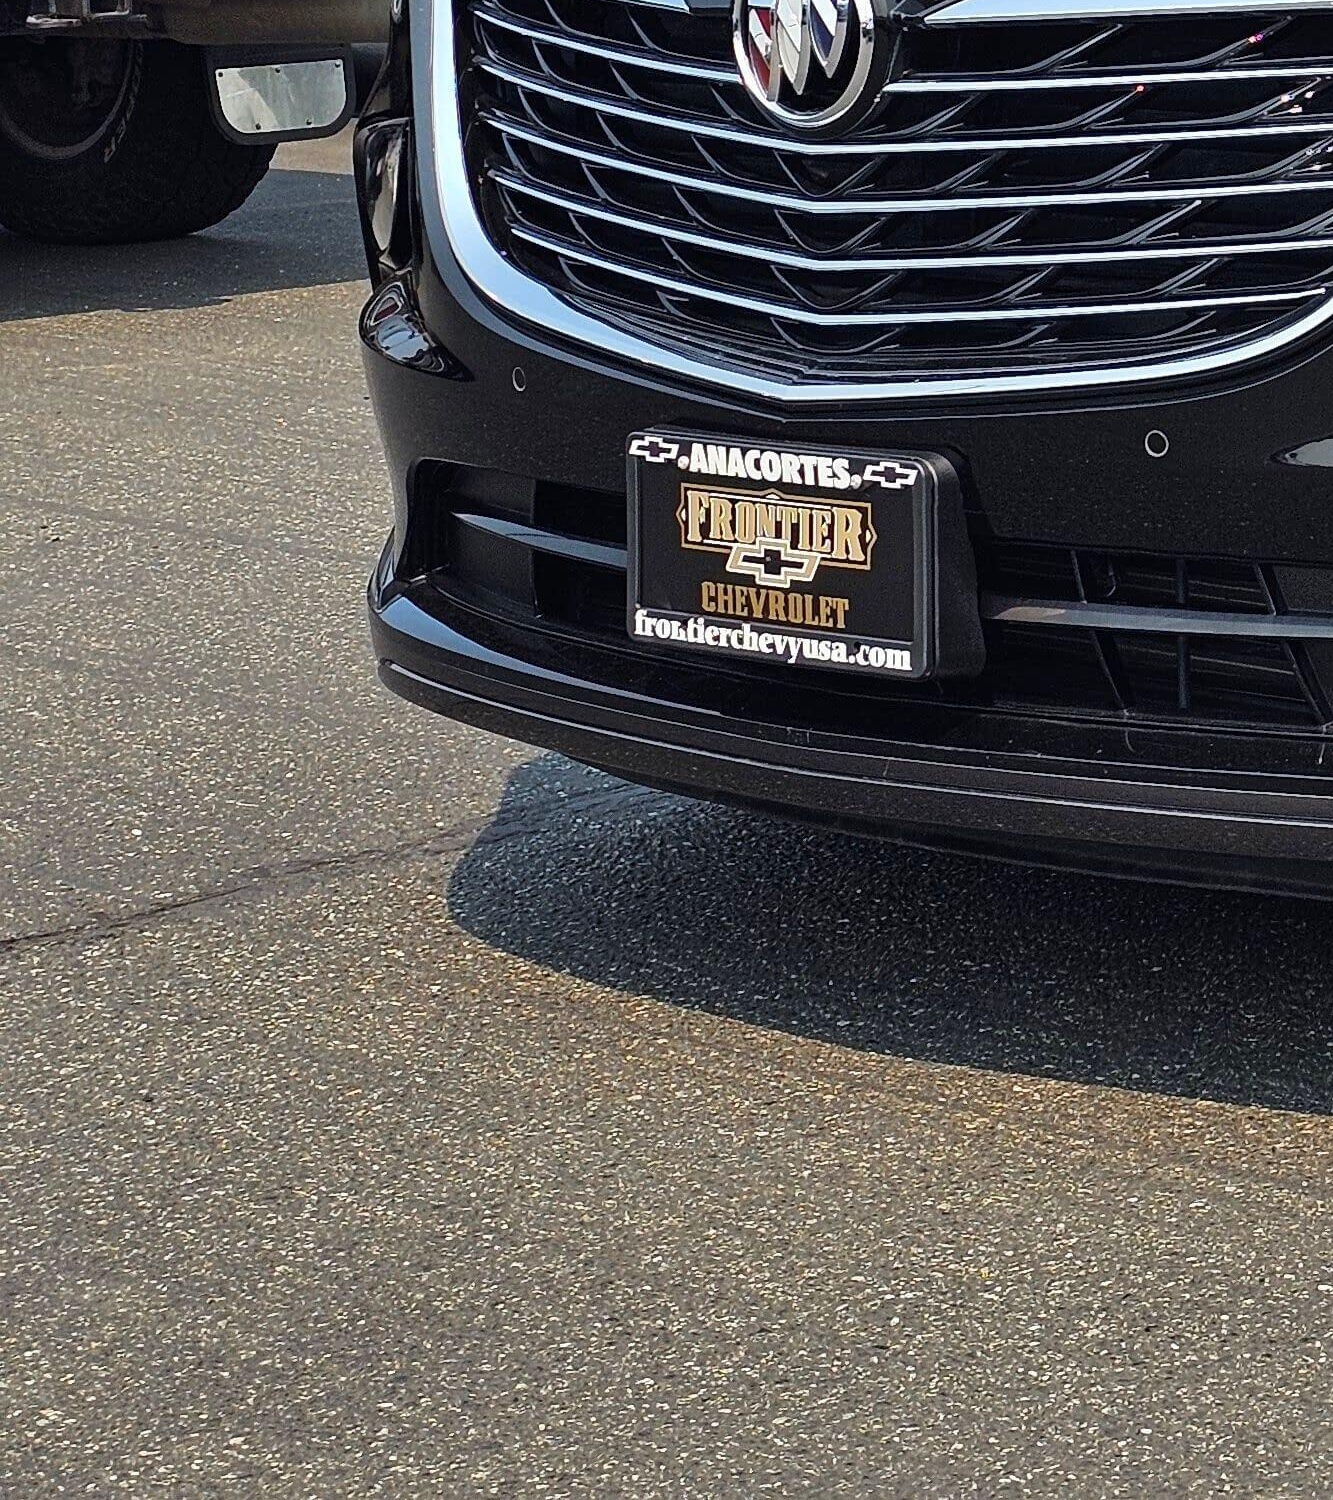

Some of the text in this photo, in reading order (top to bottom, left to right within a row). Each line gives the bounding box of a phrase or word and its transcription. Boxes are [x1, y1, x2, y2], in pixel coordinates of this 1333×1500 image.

[689, 443, 853, 489] ANACORTES
[686, 490, 867, 562] FRONTIER
[701, 582, 849, 629] CHEVROLET
[633, 610, 912, 671] frontierchevyusa.com
